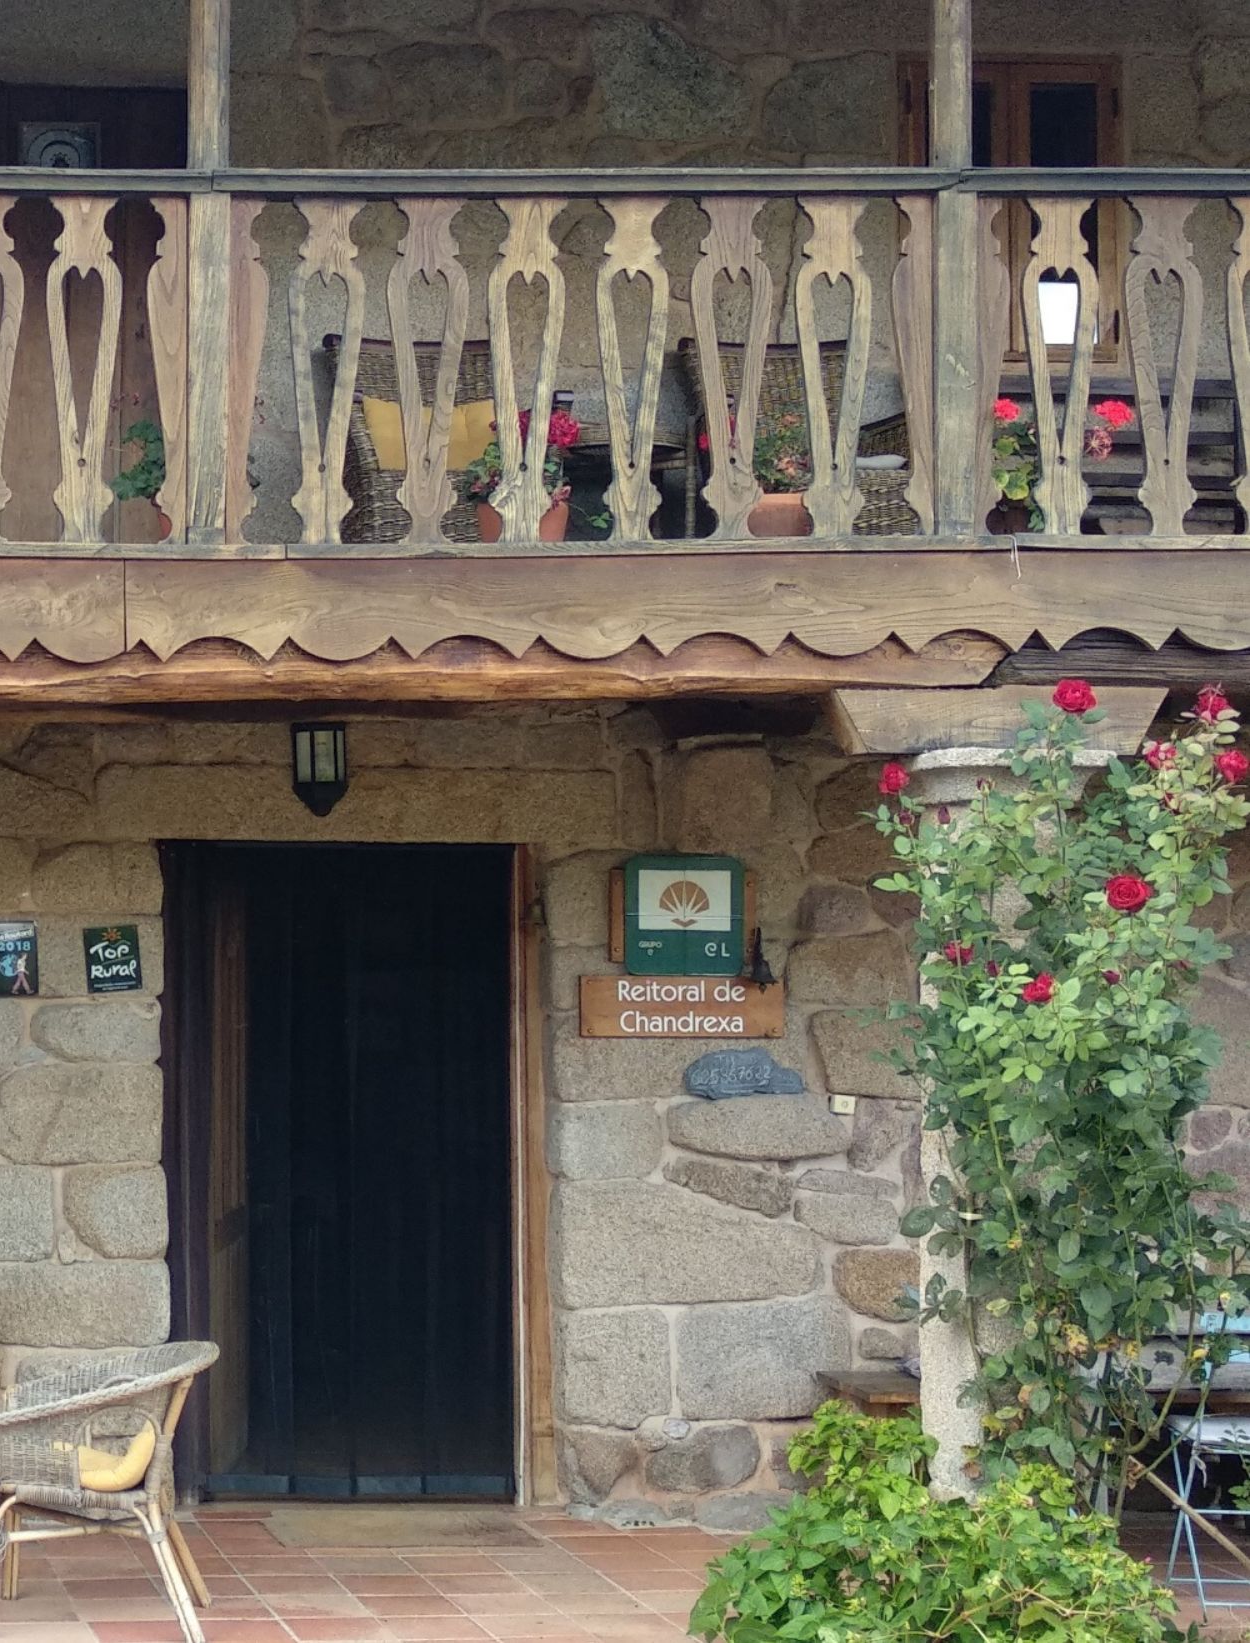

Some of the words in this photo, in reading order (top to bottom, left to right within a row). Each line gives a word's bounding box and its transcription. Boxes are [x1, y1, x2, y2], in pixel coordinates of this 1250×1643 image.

[90, 959, 137, 980] Rural
[617, 979, 705, 1003] Reitoral
[713, 979, 746, 1003] de
[619, 1010, 744, 1034] Chandrexa
